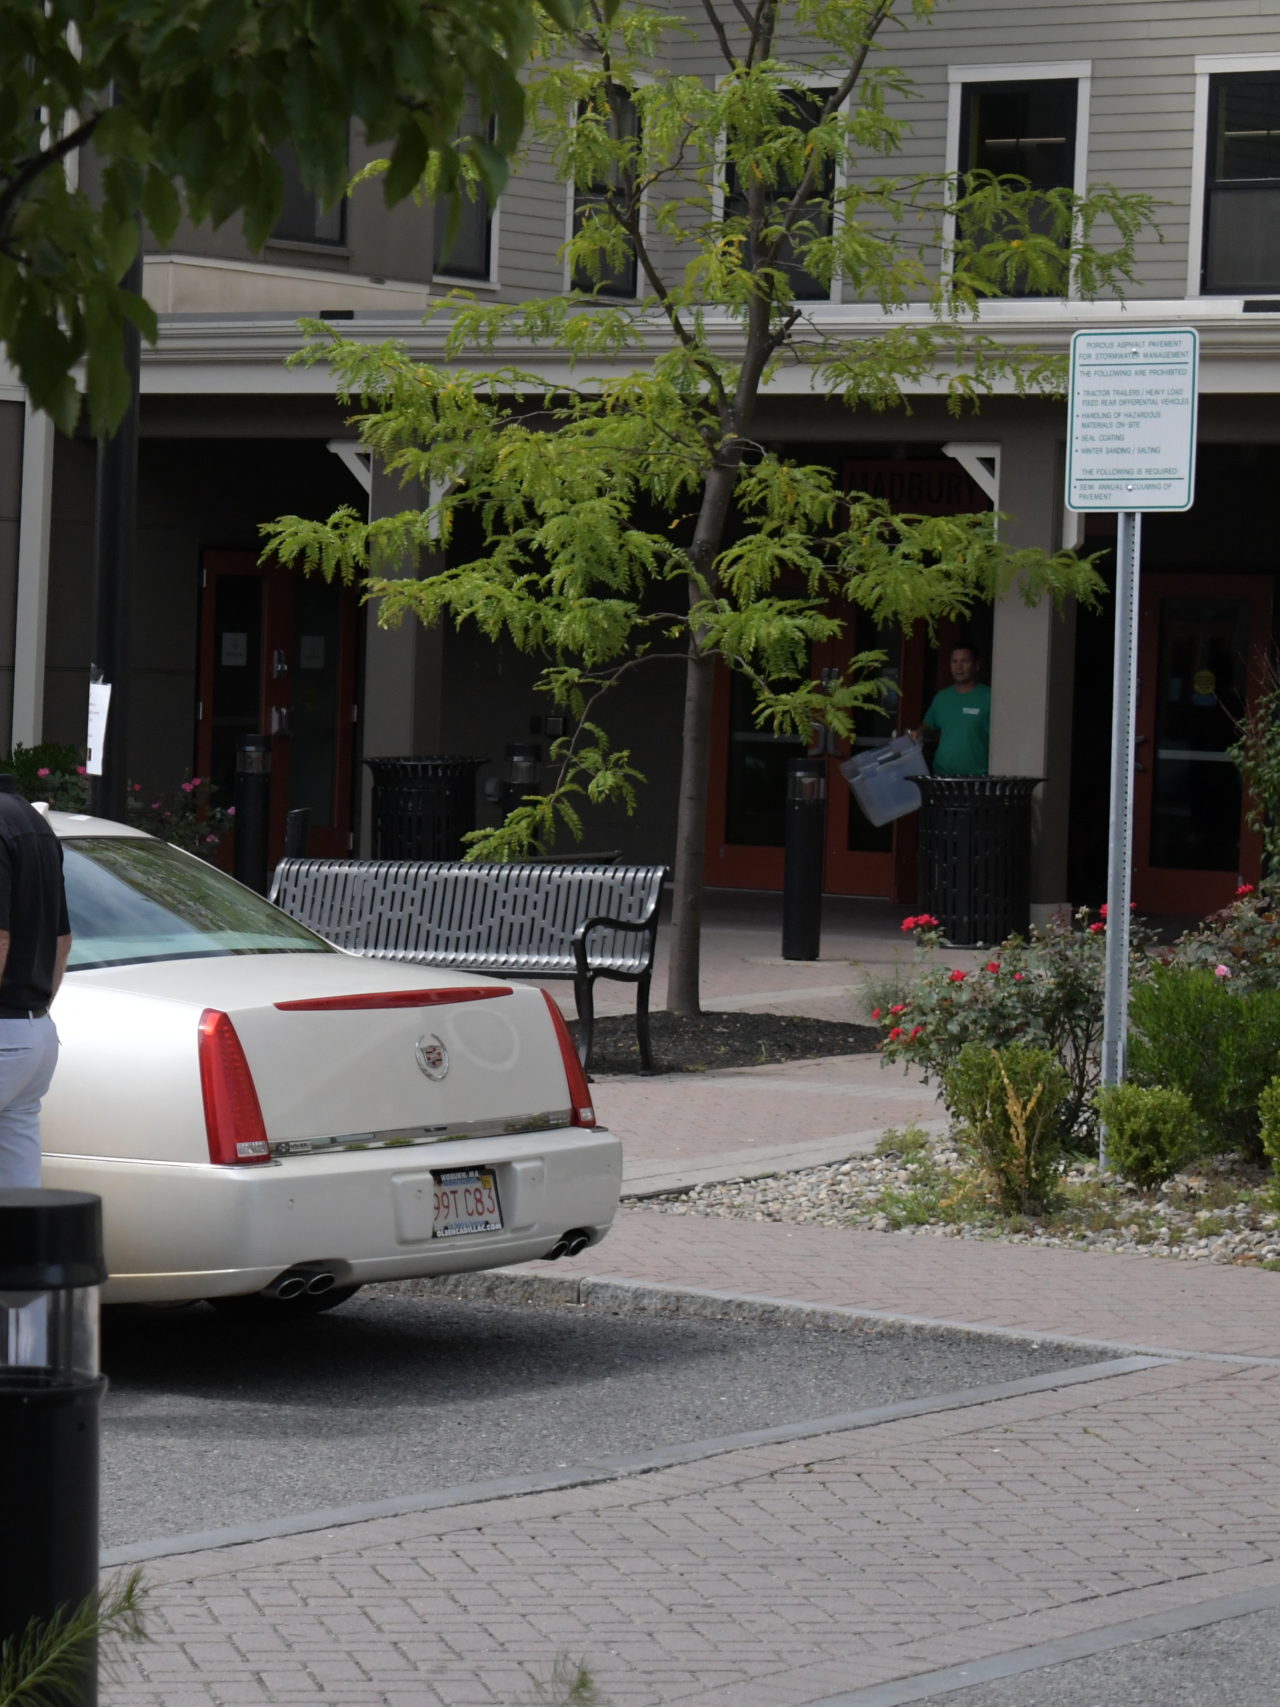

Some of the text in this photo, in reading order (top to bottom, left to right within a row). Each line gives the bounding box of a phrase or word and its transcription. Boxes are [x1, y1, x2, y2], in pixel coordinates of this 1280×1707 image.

[1095, 352, 1140, 360] STORMWATER
[1094, 369, 1132, 377] FOLLOWING
[1149, 368, 1187, 376] PROHIBITED
[1119, 398, 1158, 406] DIFFERENTIAL
[1137, 446, 1161, 454] SALTING
